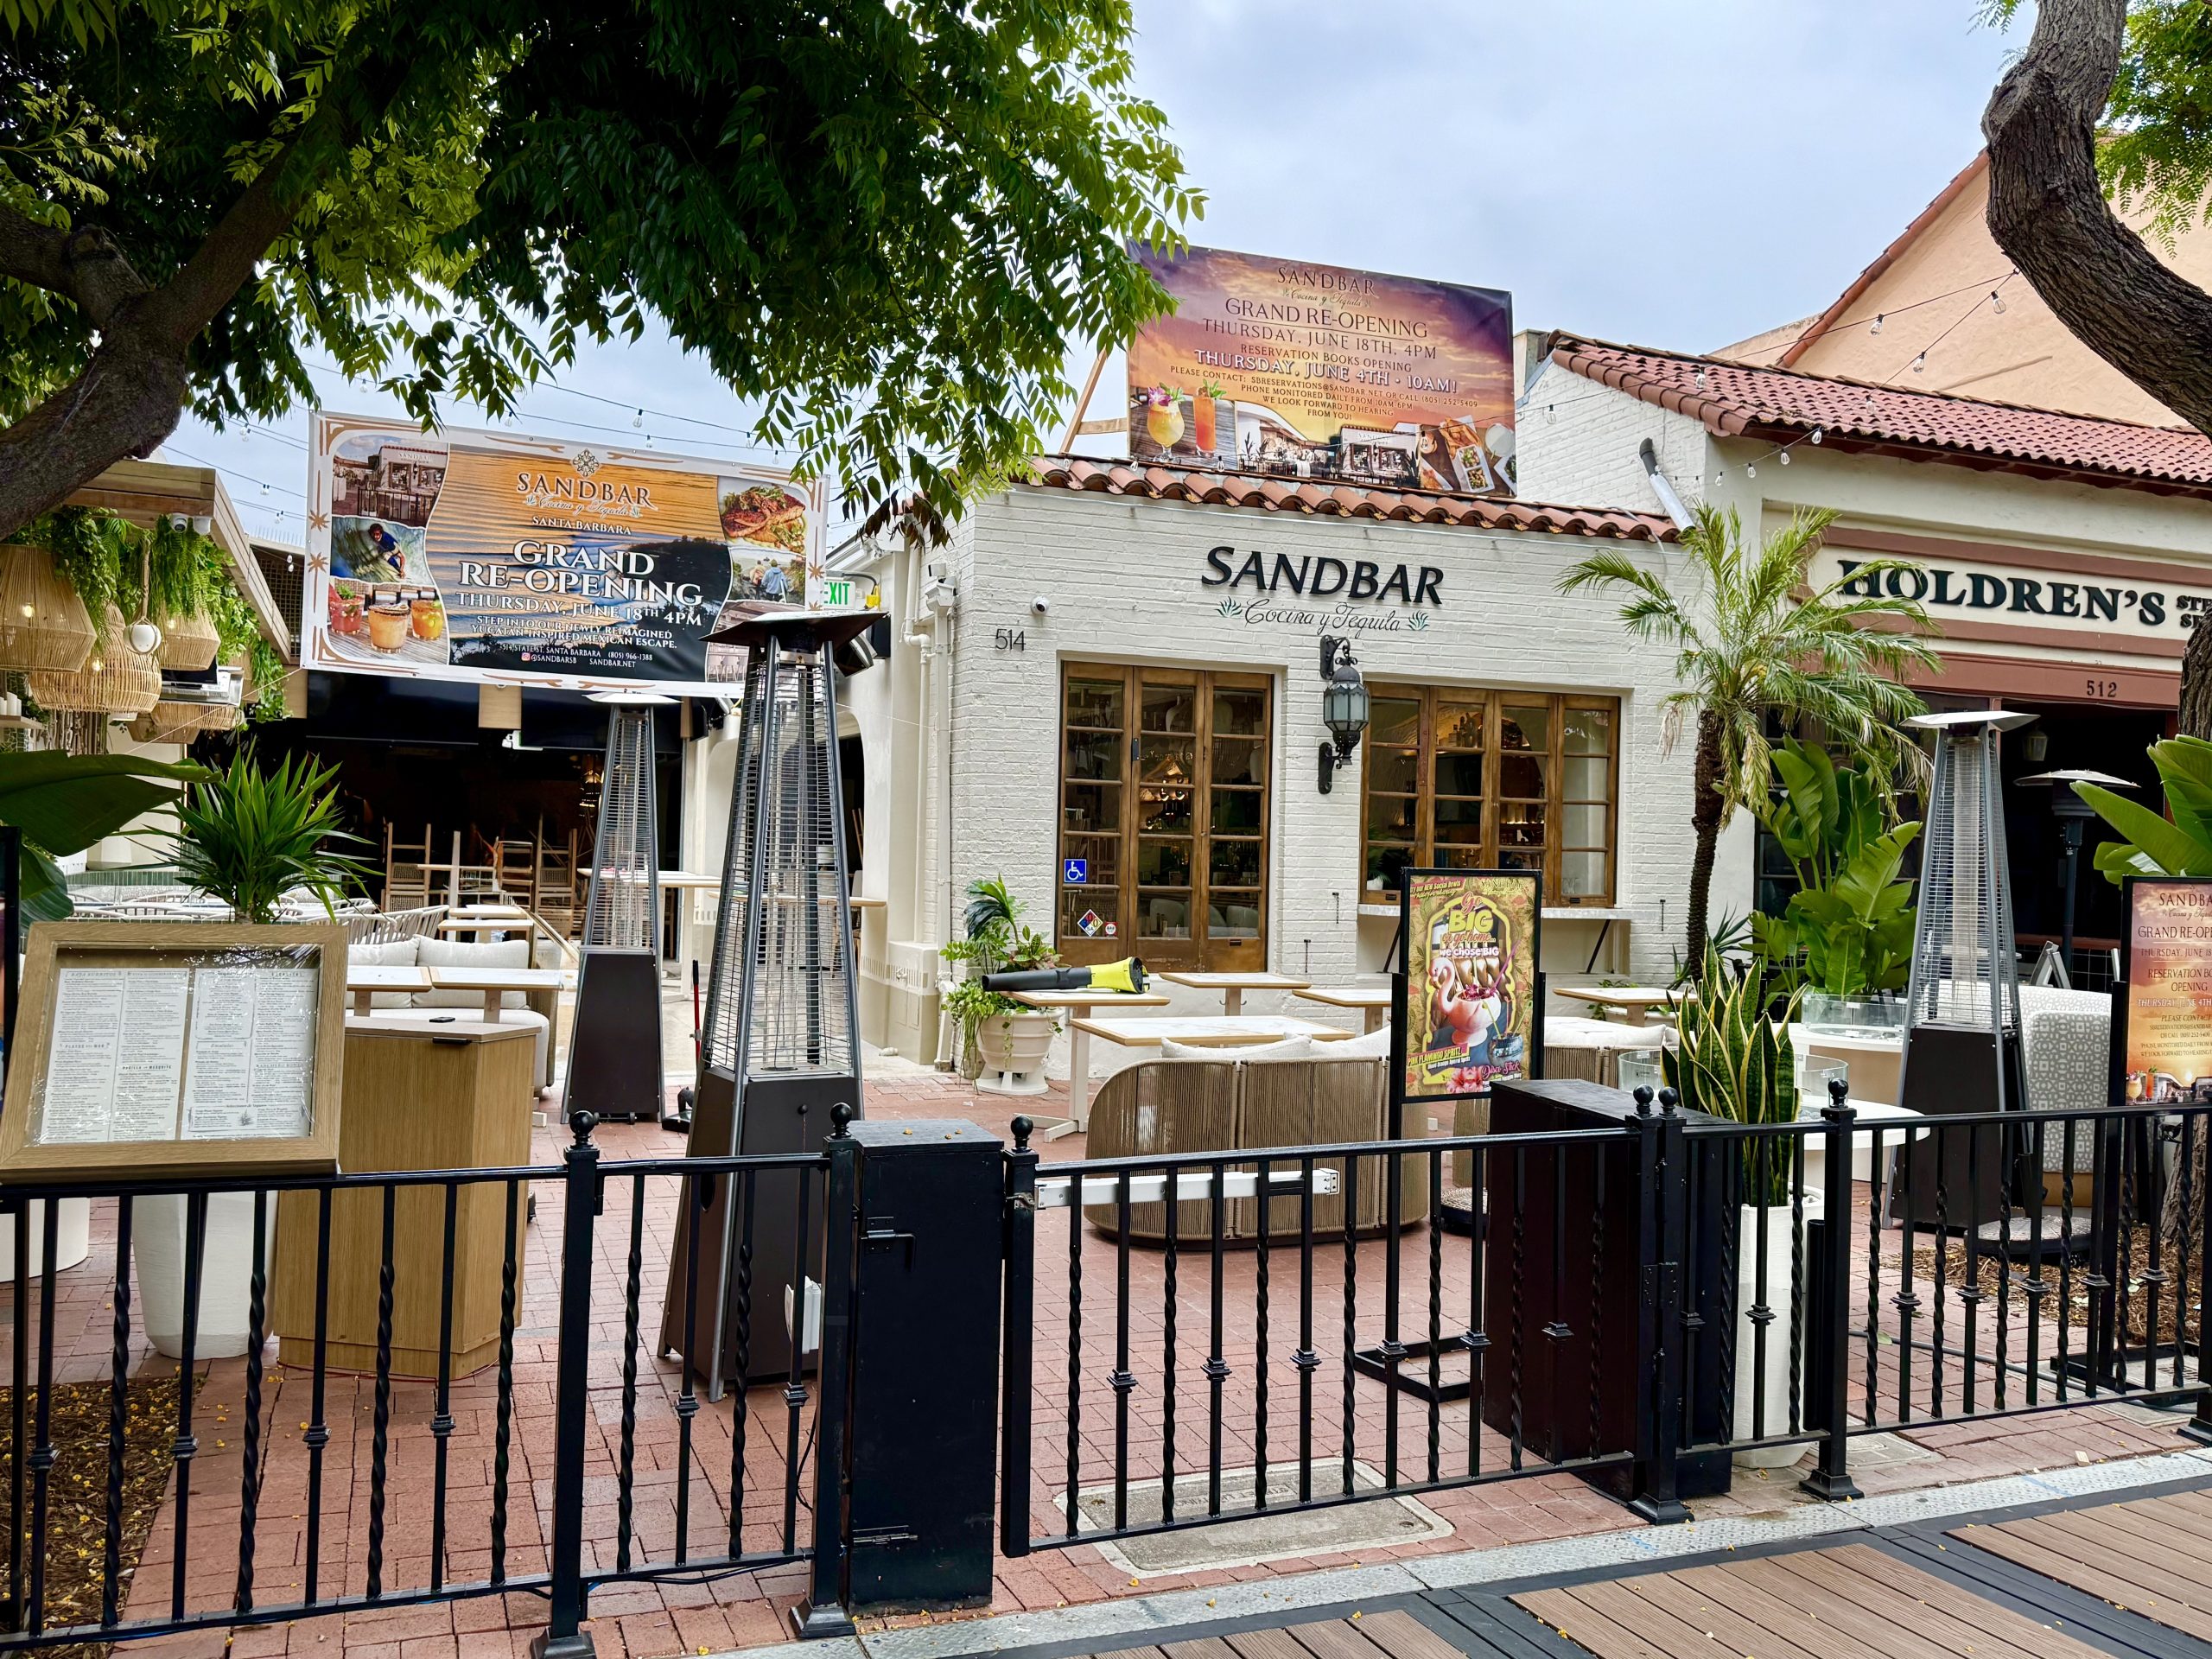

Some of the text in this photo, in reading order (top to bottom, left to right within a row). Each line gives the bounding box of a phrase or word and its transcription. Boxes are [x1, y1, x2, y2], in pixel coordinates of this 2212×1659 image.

[1278, 267, 1378, 298] SANDBAR
[1291, 289, 1361, 309] Cocina y Tequila
[1225, 297, 1427, 338] GRAND RE-OPENING
[1308, 332, 1349, 349] JUNE
[1404, 345, 1436, 359] 4PM
[1242, 344, 1412, 372] RESERVATION BOOKS OPENING
[1194, 349, 1457, 393] THURSDAY, JUNE 4TH 10AM!
[1171, 366, 1200, 377] PLEASE
[1203, 370, 1246, 382] CONTACT:
[1422, 395, 1440, 404] (805)
[1444, 398, 1478, 407] 252-5409
[1241, 385, 1269, 394] PHONE
[1273, 388, 1323, 399] MONITORED
[1326, 393, 1348, 402] DAILY
[1351, 396, 1373, 404] FROM
[1278, 397, 1300, 406] LOOK
[1304, 400, 1342, 410] FORWARD
[1358, 406, 1394, 416] HEARING
[1307, 409, 1330, 417] FROM
[518, 473, 658, 510] SANDBAR
[539, 497, 627, 518] Cocina y Tequila
[532, 516, 632, 535] SANTA BARBARA
[513, 540, 655, 575] GRAND
[460, 561, 703, 606] RE-OPENING
[1201, 546, 1443, 605] SANDBAR
[1837, 560, 2166, 626] HOLDREN'S
[455, 592, 566, 615] THURSDAY,
[572, 602, 619, 619] JUNE
[664, 611, 702, 626] 4PM
[1244, 598, 1401, 639] Cocina y Tequila
[477, 615, 672, 639] STEP INTO OUR NEWLY REIMAGINED
[583, 634, 632, 645] MEXICAN
[636, 638, 677, 649] ESCAPE.
[995, 629, 1027, 651] 514
[531, 653, 636, 668] @SANDBARSB SANDBAR.NET
[626, 652, 653, 661] 966-1388
[2087, 680, 2118, 698] 512
[1461, 891, 1481, 914] Go
[1449, 909, 1493, 933] BIG
[1442, 933, 1452, 945] or
[1453, 933, 1464, 947] go
[2139, 926, 2177, 938] GRAND
[1453, 947, 1481, 957] chose
[1483, 946, 1499, 957] BIG
[2185, 948, 2204, 957] JUNE
[2148, 969, 2202, 978] RESERVATION
[2171, 982, 2208, 992] OPENING
[2179, 999, 2196, 1008] JUNE
[2198, 998, 2212, 1007] 4TH
[1408, 1056, 1418, 1066] PINK
[1419, 1050, 1444, 1064] FLAMINGO
[1445, 1046, 1461, 1058] SPRITZ
[1482, 1065, 1501, 1080] Disco
[1503, 1061, 1521, 1074] Stick
